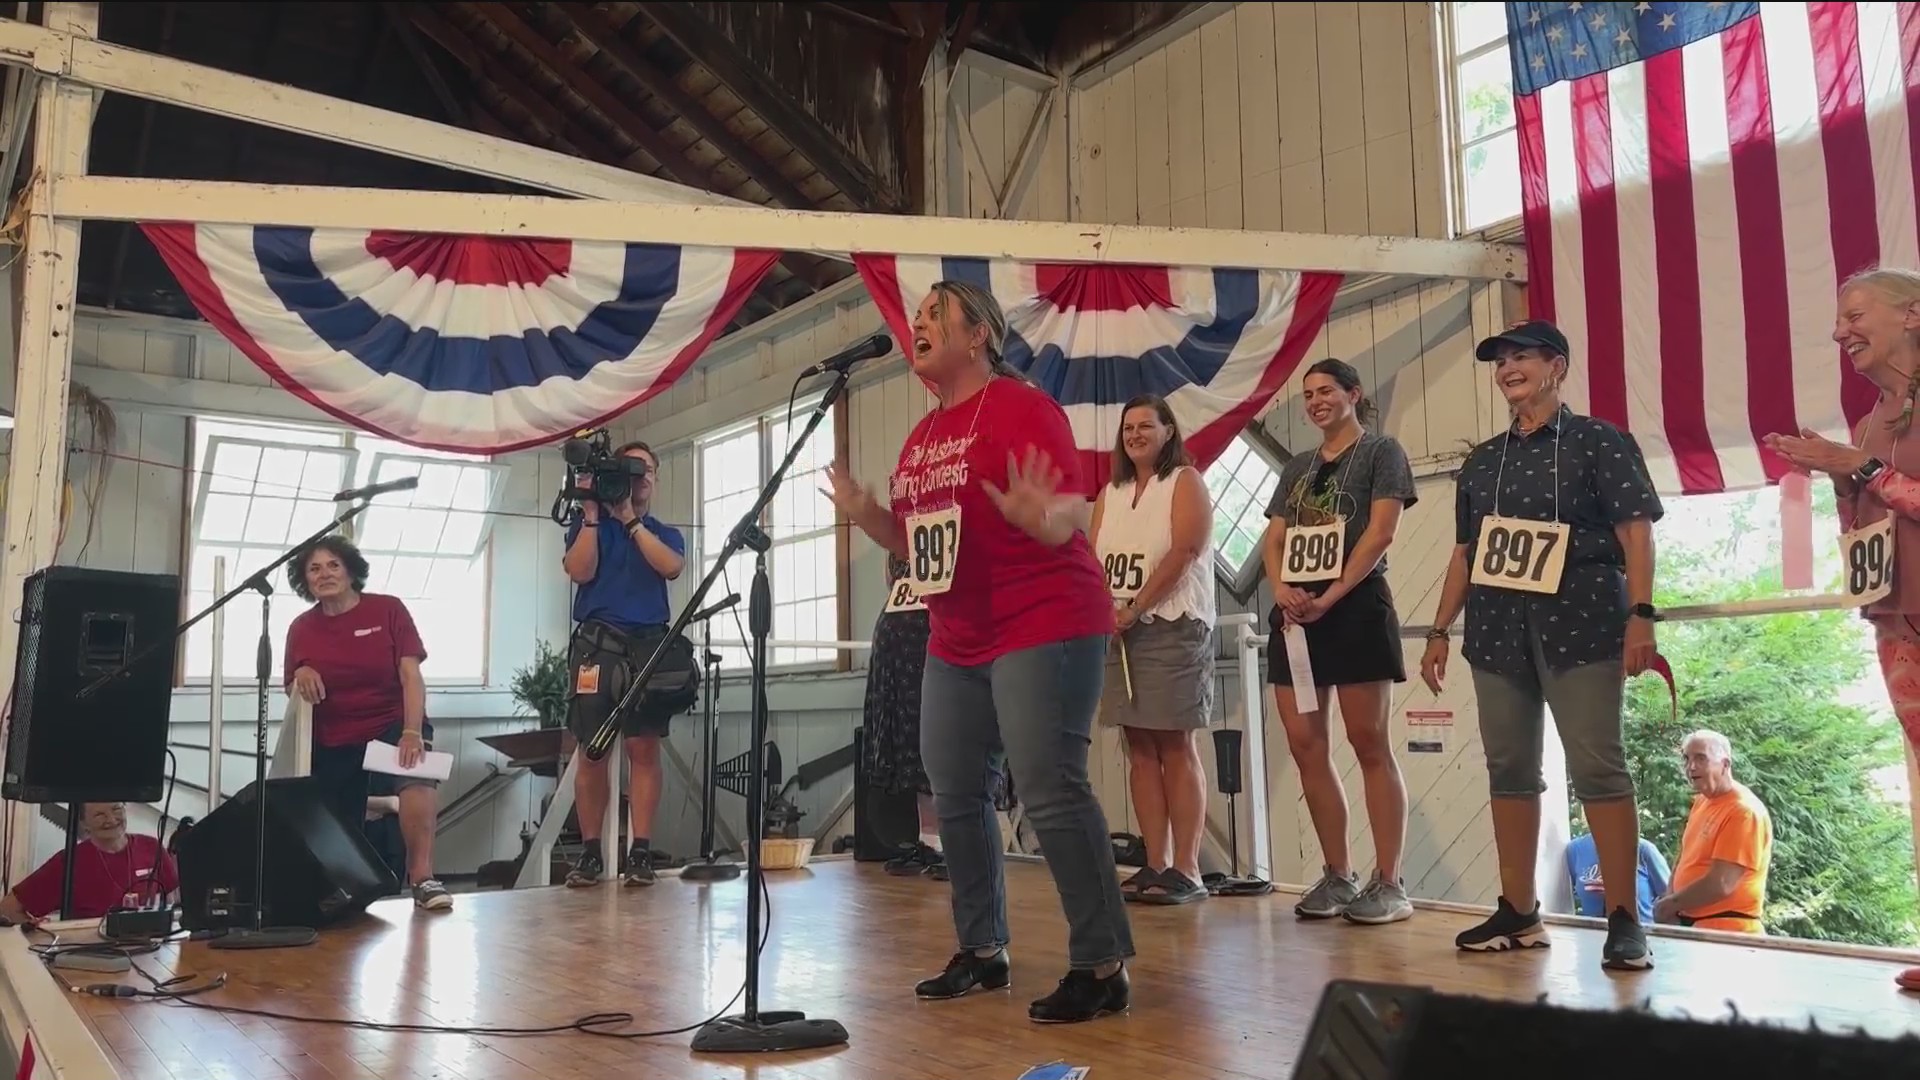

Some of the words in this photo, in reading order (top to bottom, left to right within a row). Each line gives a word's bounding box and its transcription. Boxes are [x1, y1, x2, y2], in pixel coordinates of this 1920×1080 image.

[1104, 552, 1145, 591] 895
[1288, 531, 1339, 574] 898
[1482, 527, 1560, 582] 897
